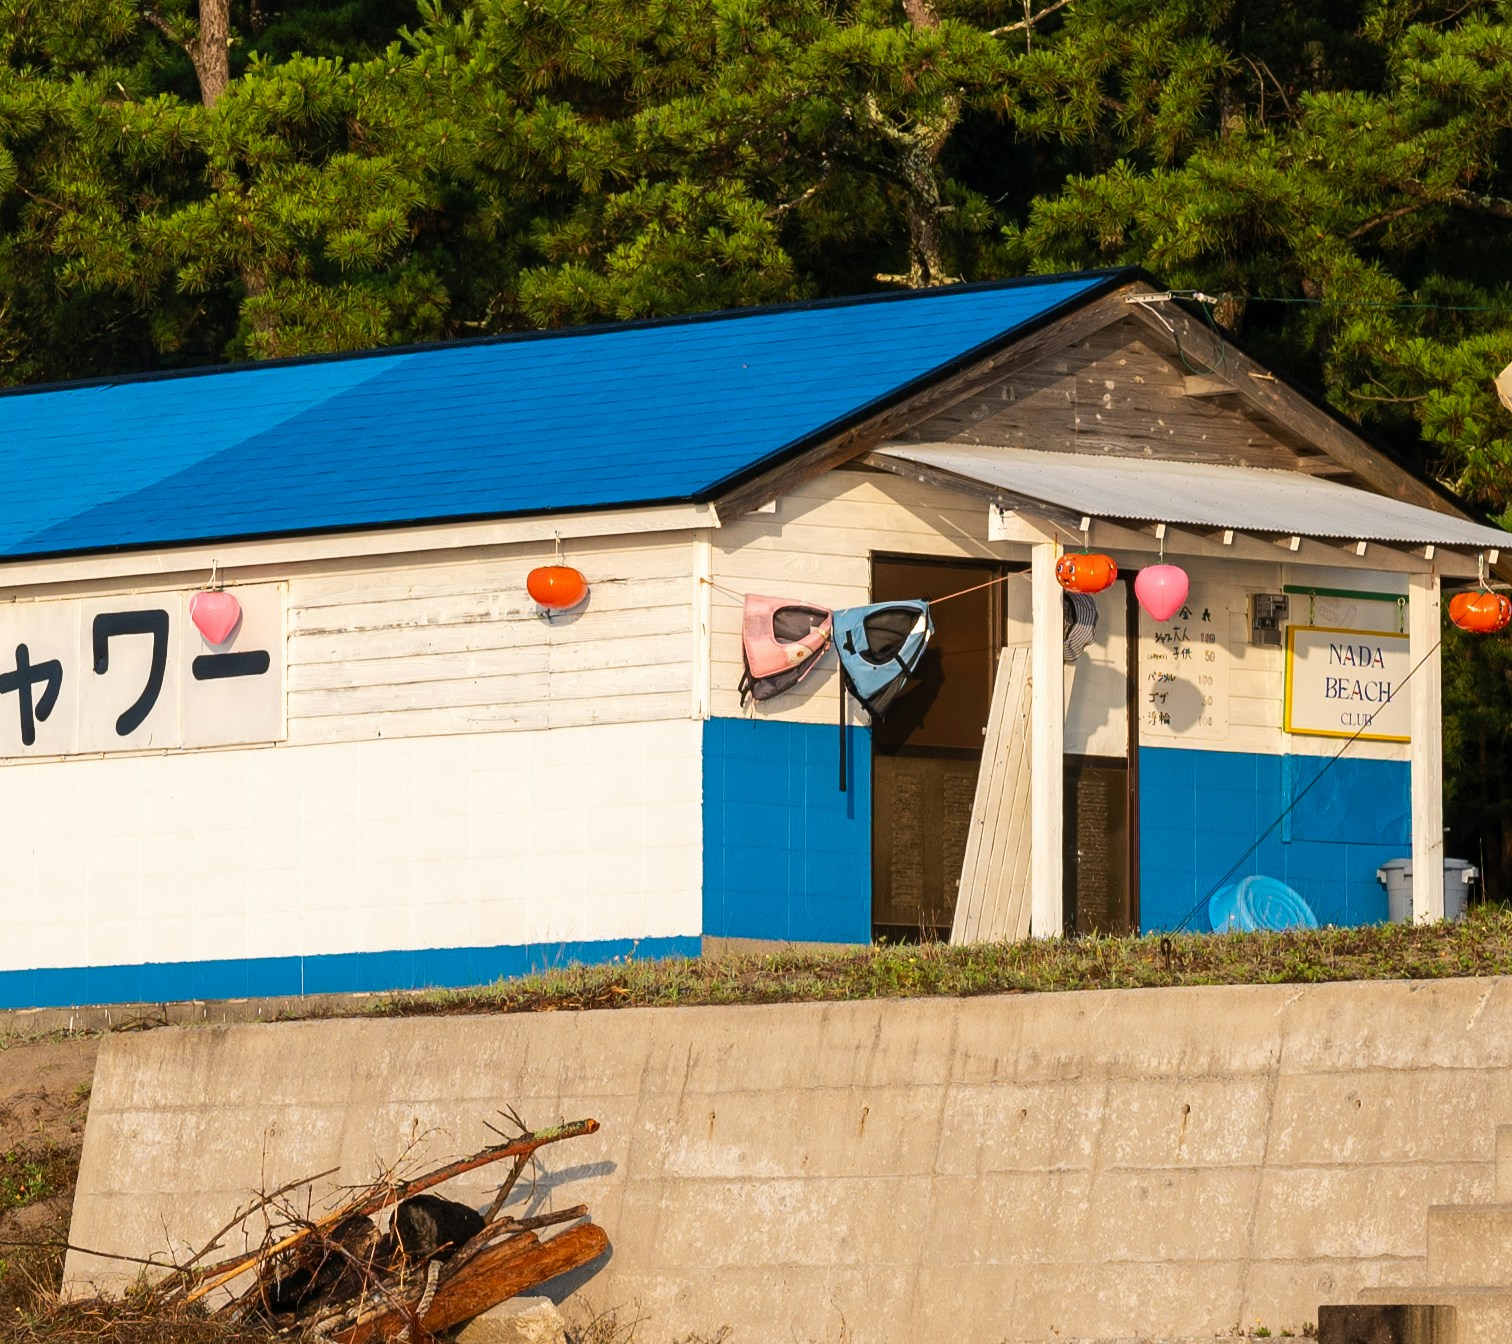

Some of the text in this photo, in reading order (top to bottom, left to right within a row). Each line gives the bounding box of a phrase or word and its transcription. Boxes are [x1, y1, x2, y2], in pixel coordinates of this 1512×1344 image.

[1172, 646, 1192, 660] 子供
[1204, 649, 1216, 662] 50
[1329, 643, 1385, 669] NADA
[1198, 675, 1214, 686] 100
[1325, 677, 1392, 703] BEACH
[1148, 692, 1169, 704] ゴザ
[1340, 712, 1373, 727] CLUB
